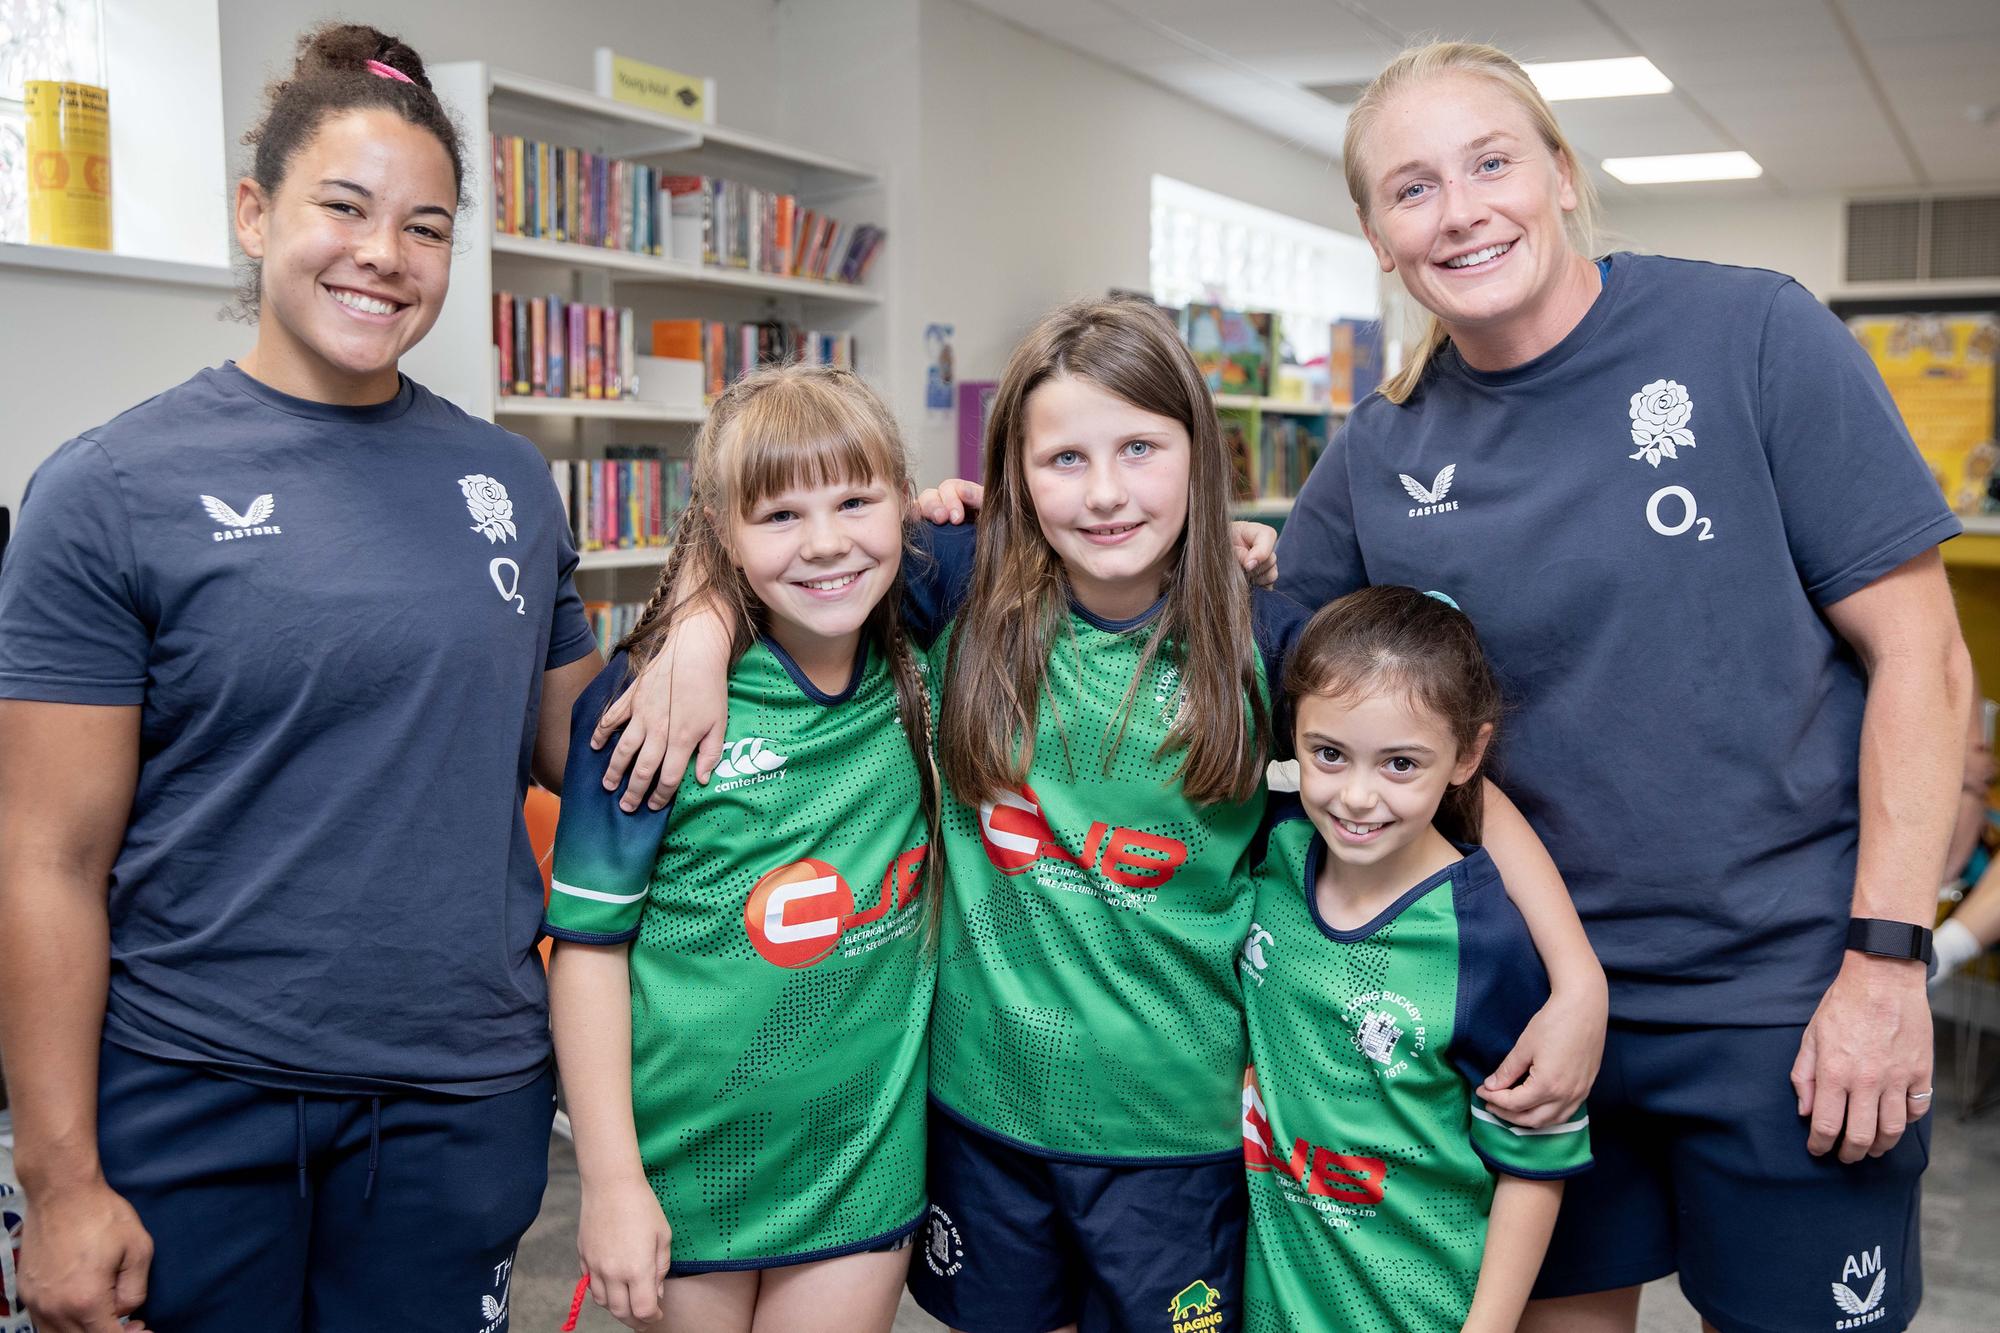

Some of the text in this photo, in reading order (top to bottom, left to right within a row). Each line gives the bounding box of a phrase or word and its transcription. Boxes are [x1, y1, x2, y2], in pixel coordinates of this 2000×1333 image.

[1408, 500, 1459, 517] CASTORE
[213, 526, 282, 542] CASTORE
[714, 768, 788, 793] canterbury
[1039, 862, 1088, 881] ELECTRICAL
[1143, 894, 1158, 903] LTD
[844, 924, 886, 945] ELECTRICAL
[1346, 990, 1426, 1052] LONG BUCKBY RFC
[1383, 1060, 1409, 1080] 1875
[1359, 1209, 1377, 1218] LTD
[494, 1251, 514, 1287] TH
[946, 1261, 963, 1277] 1875
[1842, 1245, 1882, 1283] AM
[1172, 1311, 1223, 1333] RAGING
[1835, 1306, 1886, 1330] CASTORE
